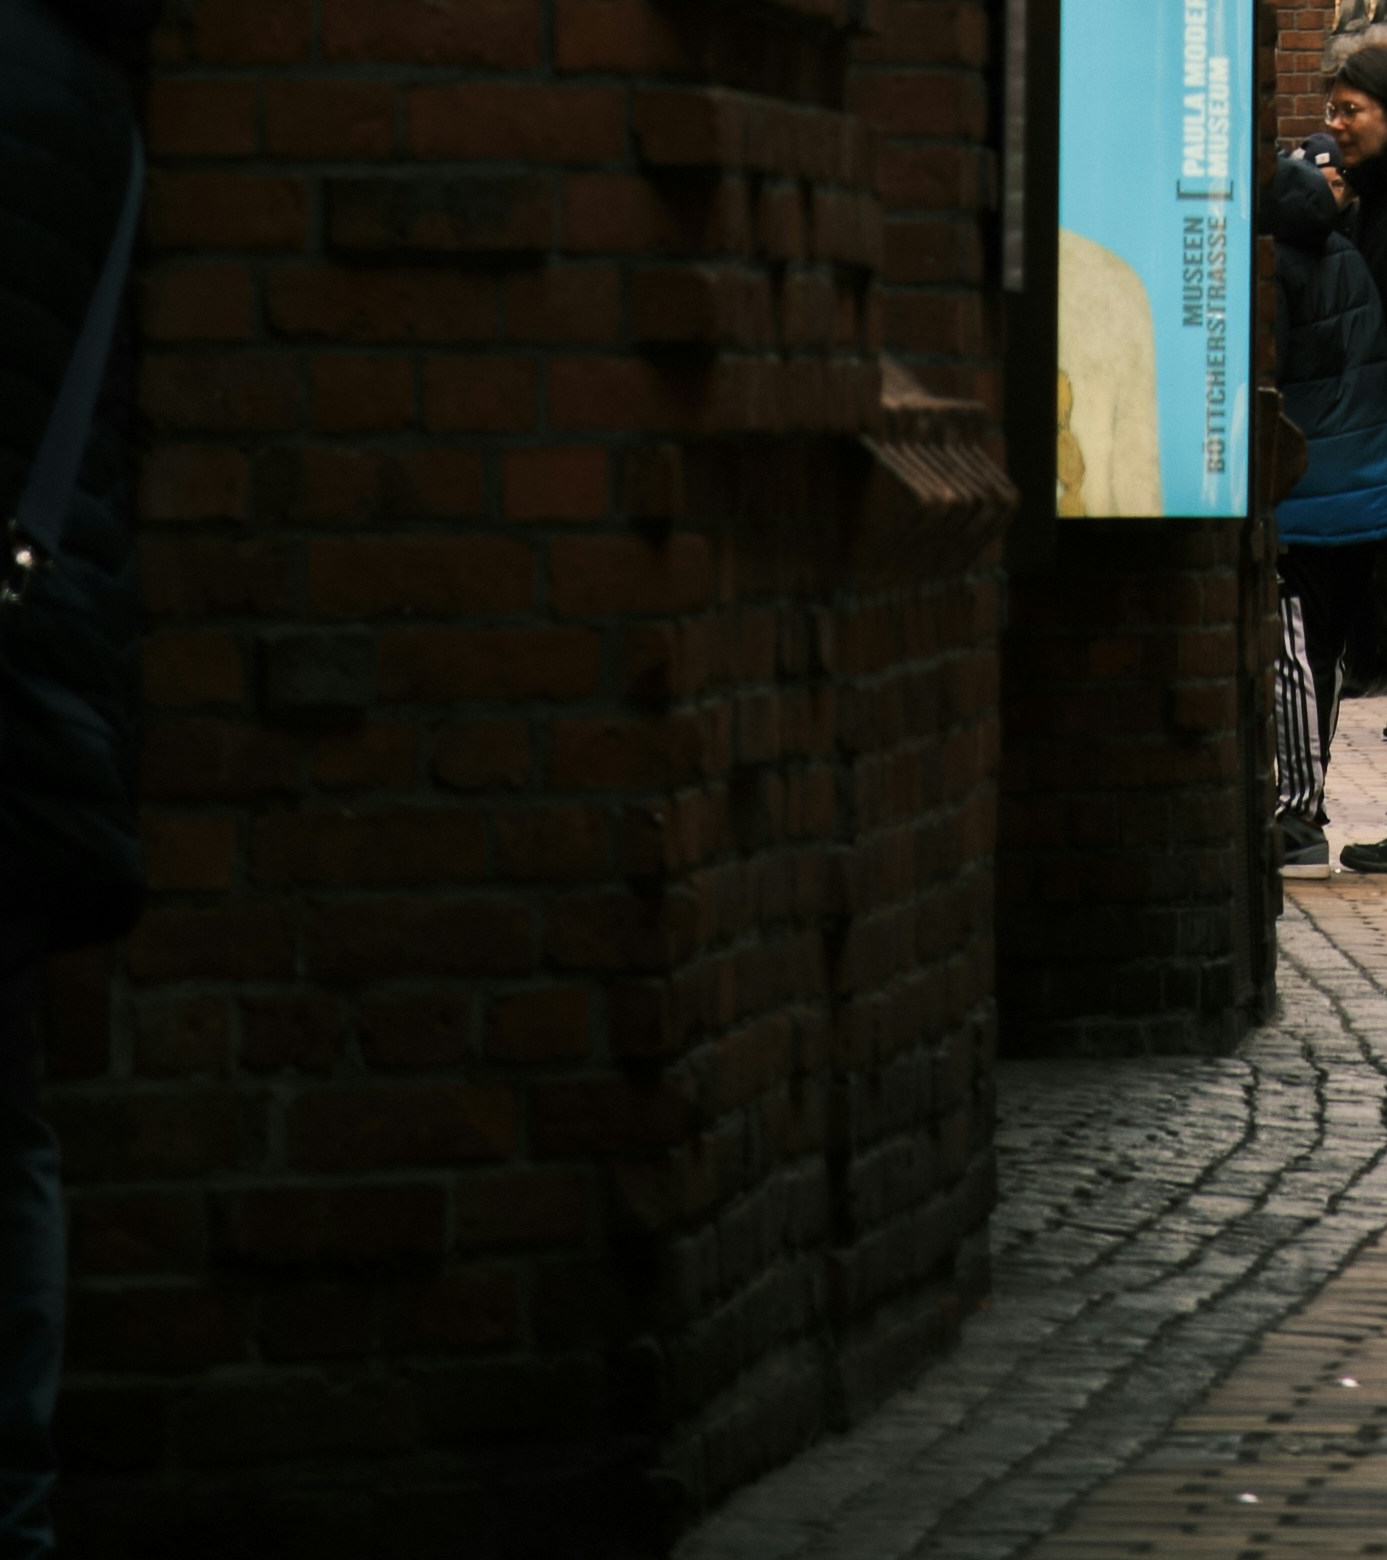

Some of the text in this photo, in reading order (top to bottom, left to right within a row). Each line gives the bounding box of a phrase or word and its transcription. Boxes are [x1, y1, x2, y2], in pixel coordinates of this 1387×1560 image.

[1183, 92, 1206, 177] PAULA
[1206, 56, 1230, 177] MUSEUM
[1183, 217, 1204, 328] MUSEEN
